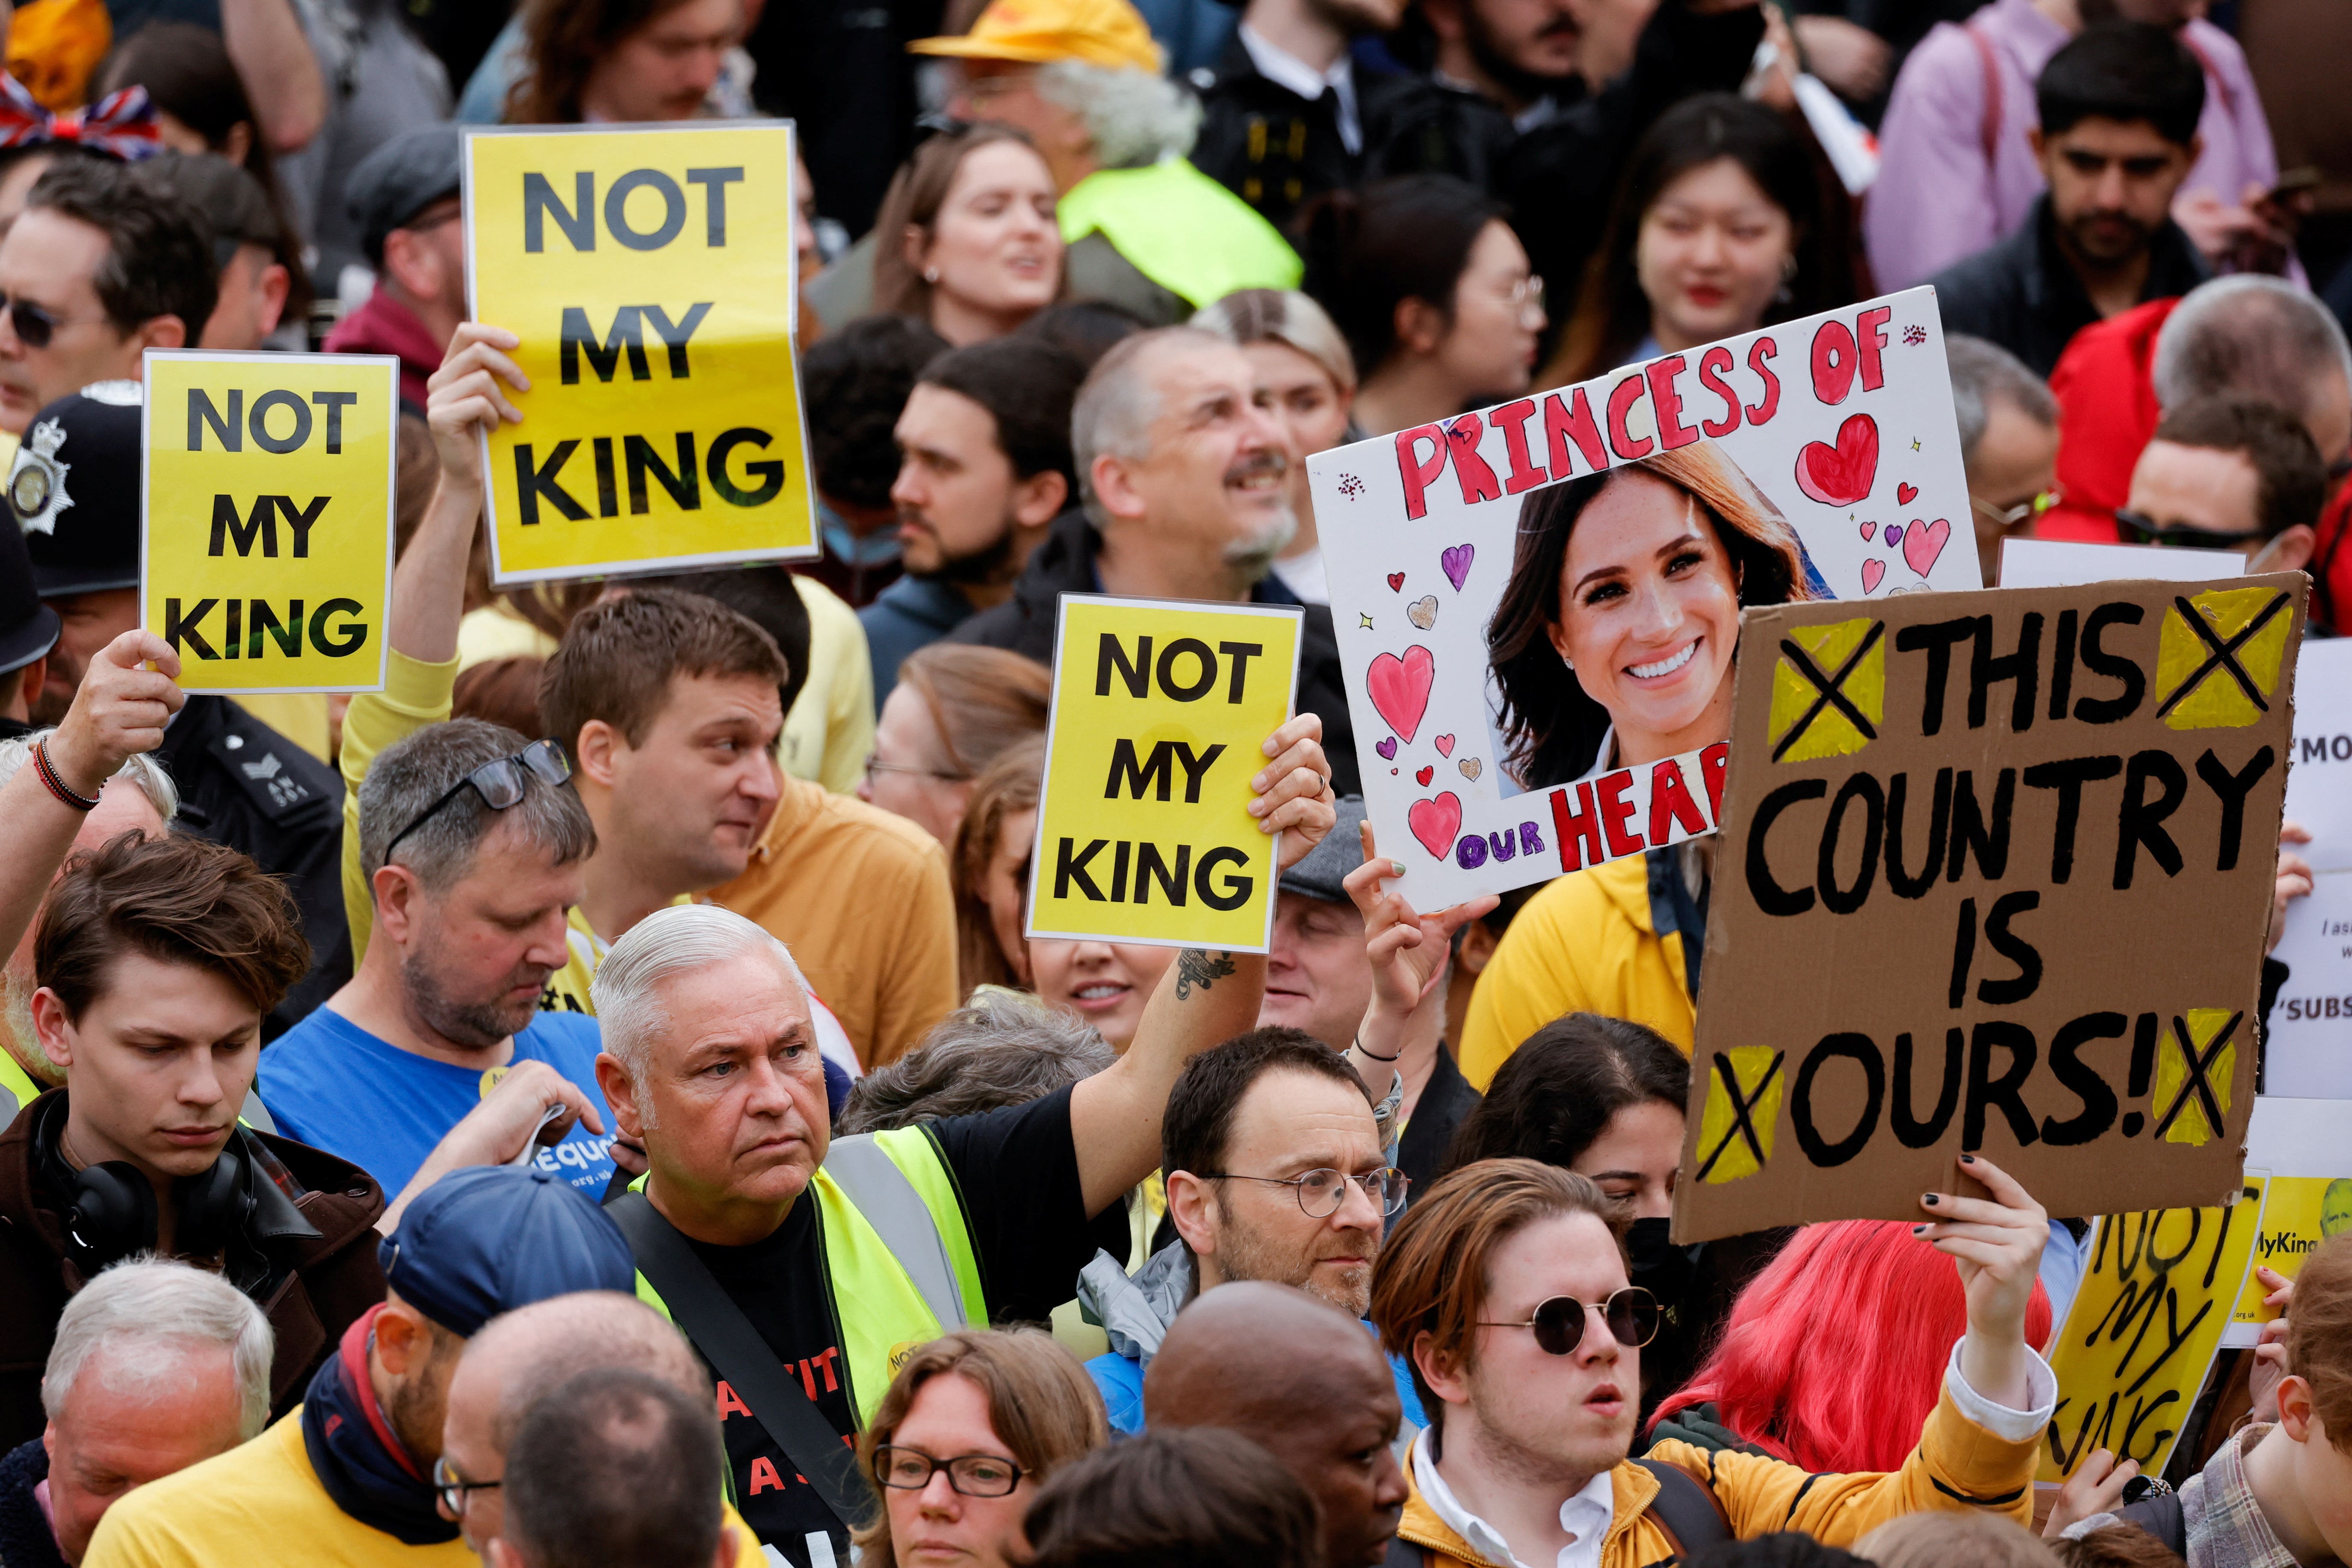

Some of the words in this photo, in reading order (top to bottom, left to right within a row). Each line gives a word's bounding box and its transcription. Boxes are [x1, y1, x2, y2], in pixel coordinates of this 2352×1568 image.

[523, 167, 745, 253] NOT
[560, 302, 715, 385] MY
[187, 388, 357, 455] NOT
[1395, 336, 1781, 520] PRINCESS
[1810, 306, 1891, 405] OF
[514, 427, 785, 526] KING
[208, 494, 332, 558] MY
[165, 598, 368, 660] KING
[1095, 633, 1263, 704] NOT
[1895, 602, 2146, 737] THIS
[1104, 738, 1228, 804] MY
[1456, 821, 1545, 870] OUR
[1745, 744, 2275, 917] COUNTRY
[1053, 837, 1253, 911] KING
[1948, 890, 2043, 1009] IS
[1790, 1011, 2158, 1168] OURS!
[2085, 1273, 2213, 1397] MY
